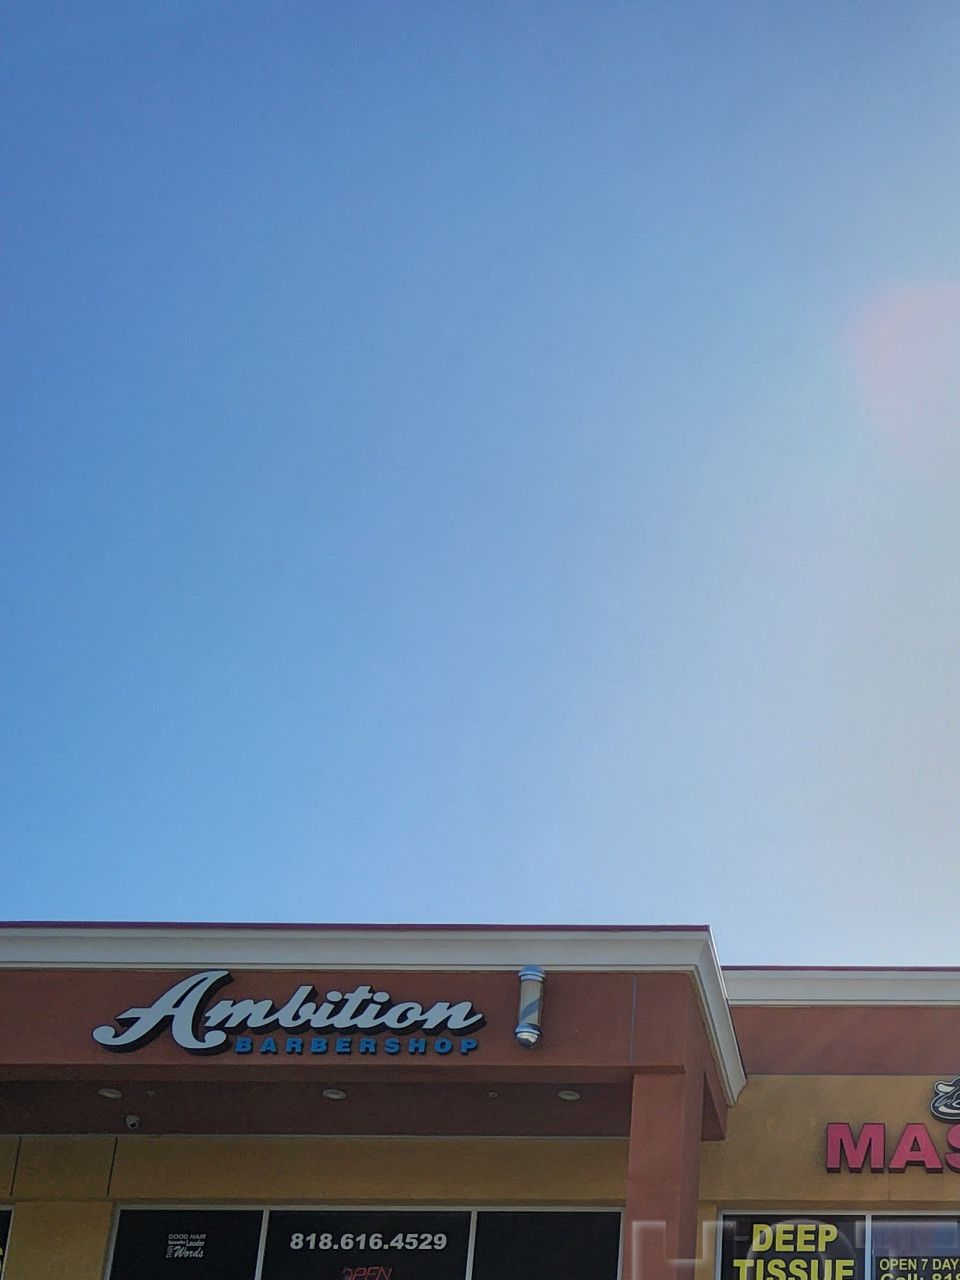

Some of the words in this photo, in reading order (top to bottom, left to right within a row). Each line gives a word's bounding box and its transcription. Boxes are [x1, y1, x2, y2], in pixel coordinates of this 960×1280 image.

[92, 969, 486, 1051] Ambition
[235, 1036, 480, 1056] BARBERSHOP
[289, 1232, 448, 1250] 818.616.4529
[752, 1223, 838, 1252] DEEP
[879, 1258, 918, 1271] OPEN
[921, 1258, 929, 1270] 7
